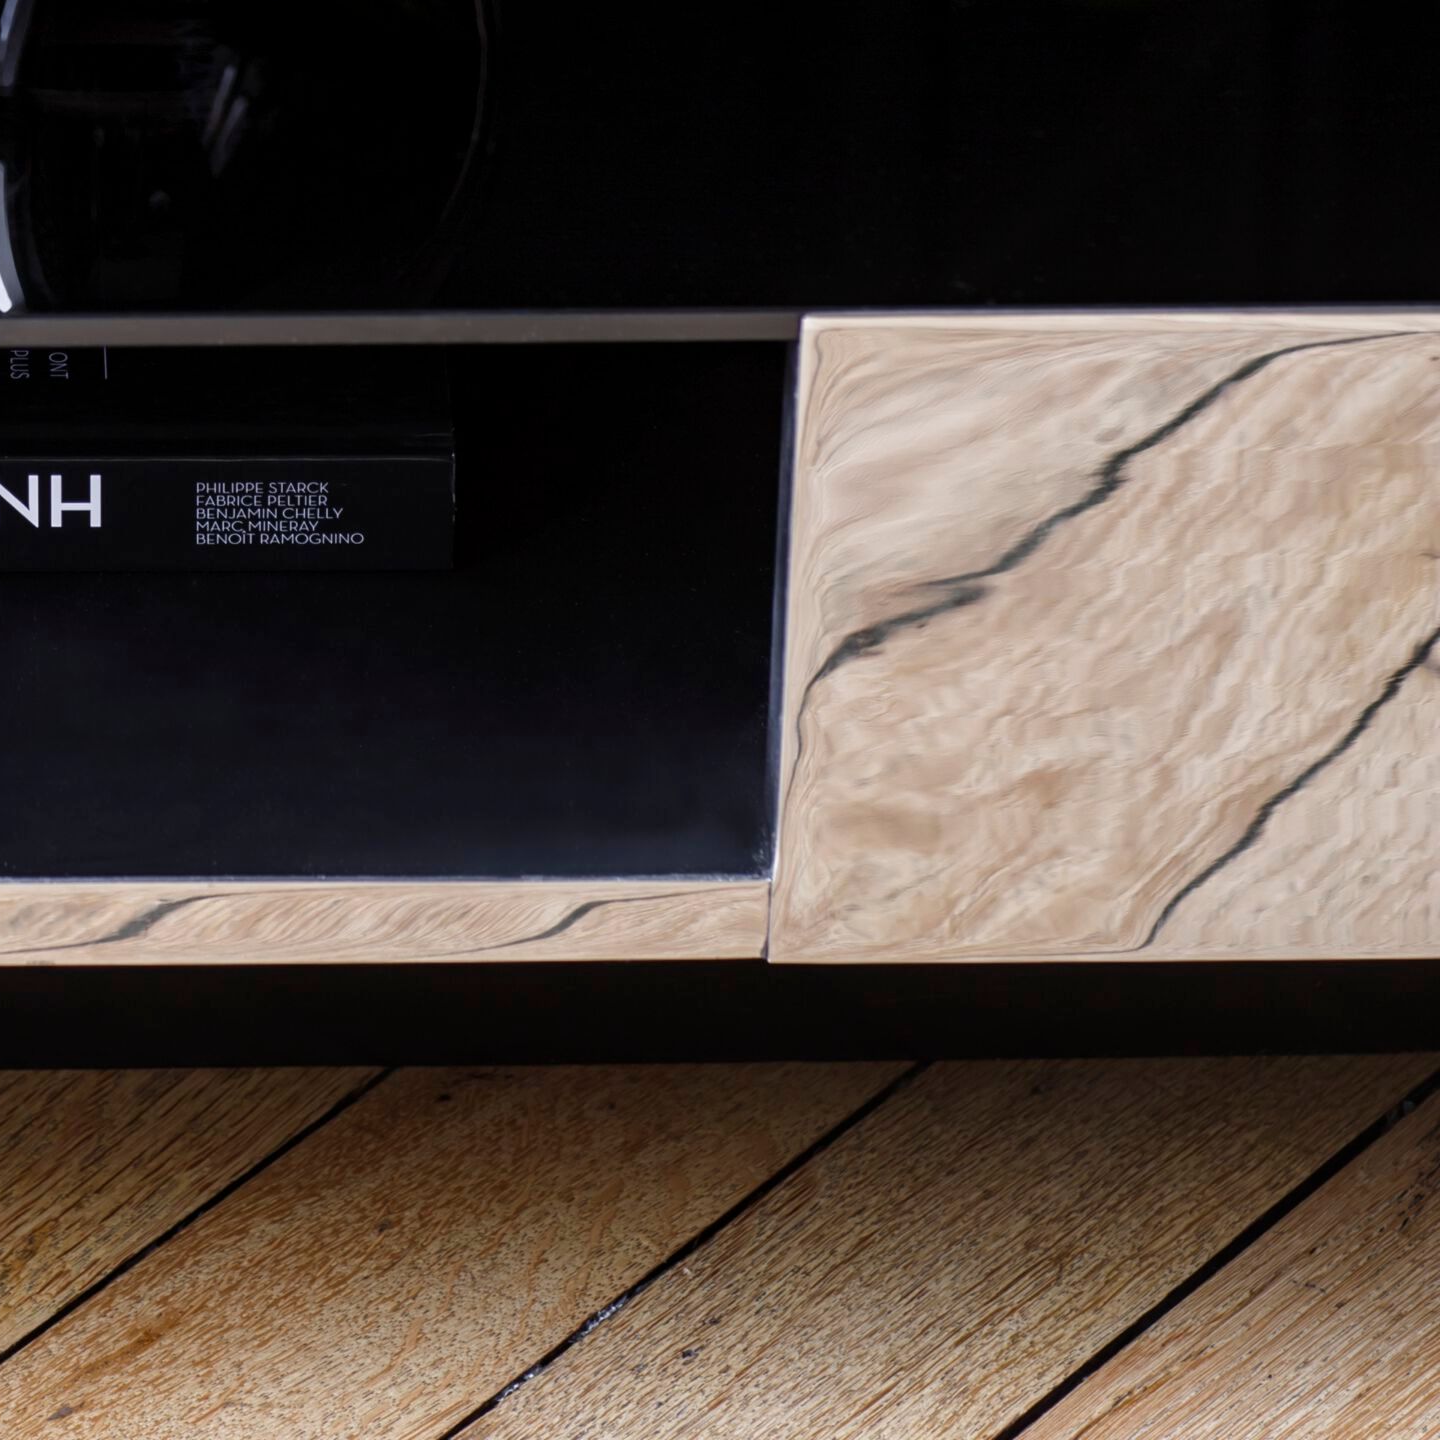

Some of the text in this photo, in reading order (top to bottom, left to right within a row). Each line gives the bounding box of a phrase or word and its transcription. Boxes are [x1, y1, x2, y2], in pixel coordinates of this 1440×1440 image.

[10, 349, 30, 380] PLUS
[49, 351, 69, 380] ONT
[196, 481, 329, 494] PHILIPPE STARCK
[196, 495, 328, 507] FABRICE PELTIER
[196, 507, 344, 519] BENJAMIN CHELLY
[196, 520, 319, 532] MARC MINERAY
[196, 530, 365, 545] BENOÎT RAMOGNINO
